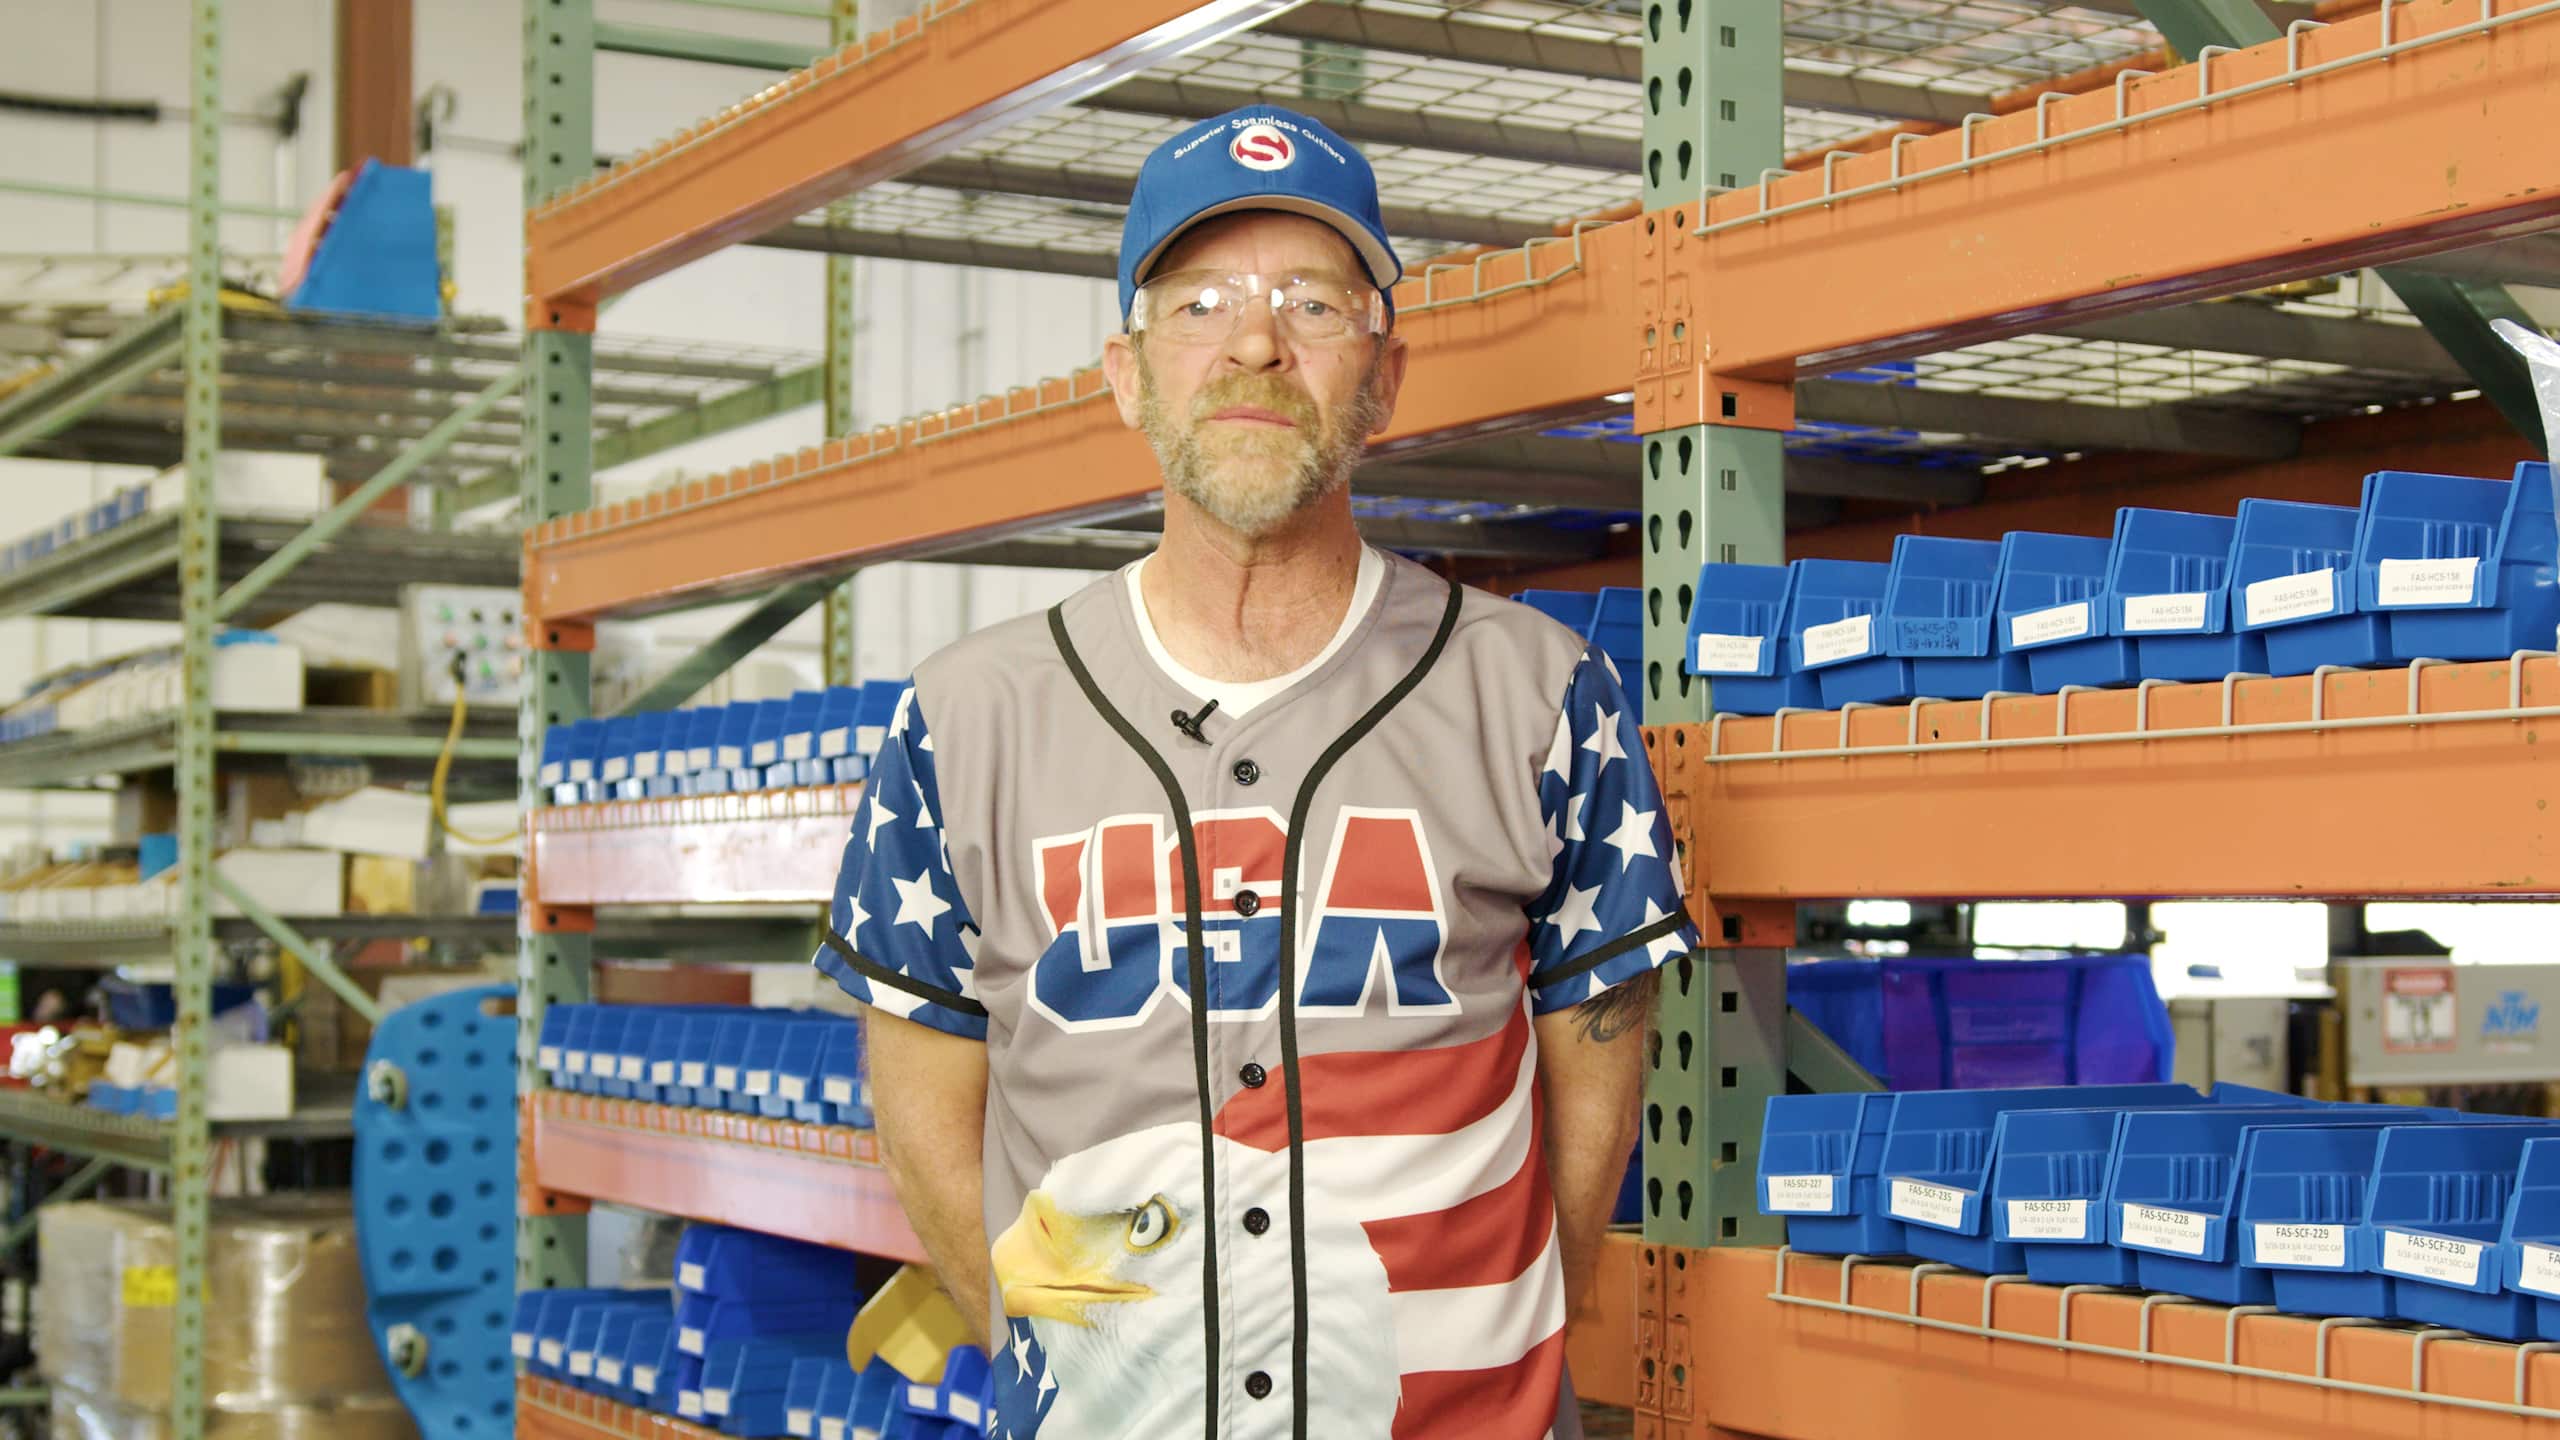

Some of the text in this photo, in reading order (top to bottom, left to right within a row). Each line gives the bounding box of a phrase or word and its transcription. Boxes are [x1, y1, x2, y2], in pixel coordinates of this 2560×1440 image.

[1174, 115, 1346, 165] Superior Seamless Gutters
[1027, 805, 1463, 1034] USA
[2024, 1202, 2072, 1212] FAS-SCF-237
[2140, 1208, 2190, 1225] FAS-SCF-228
[2275, 1227, 2329, 1239] FAS-SCF-229
[2408, 1236, 2466, 1255] FAS-SCF-230
